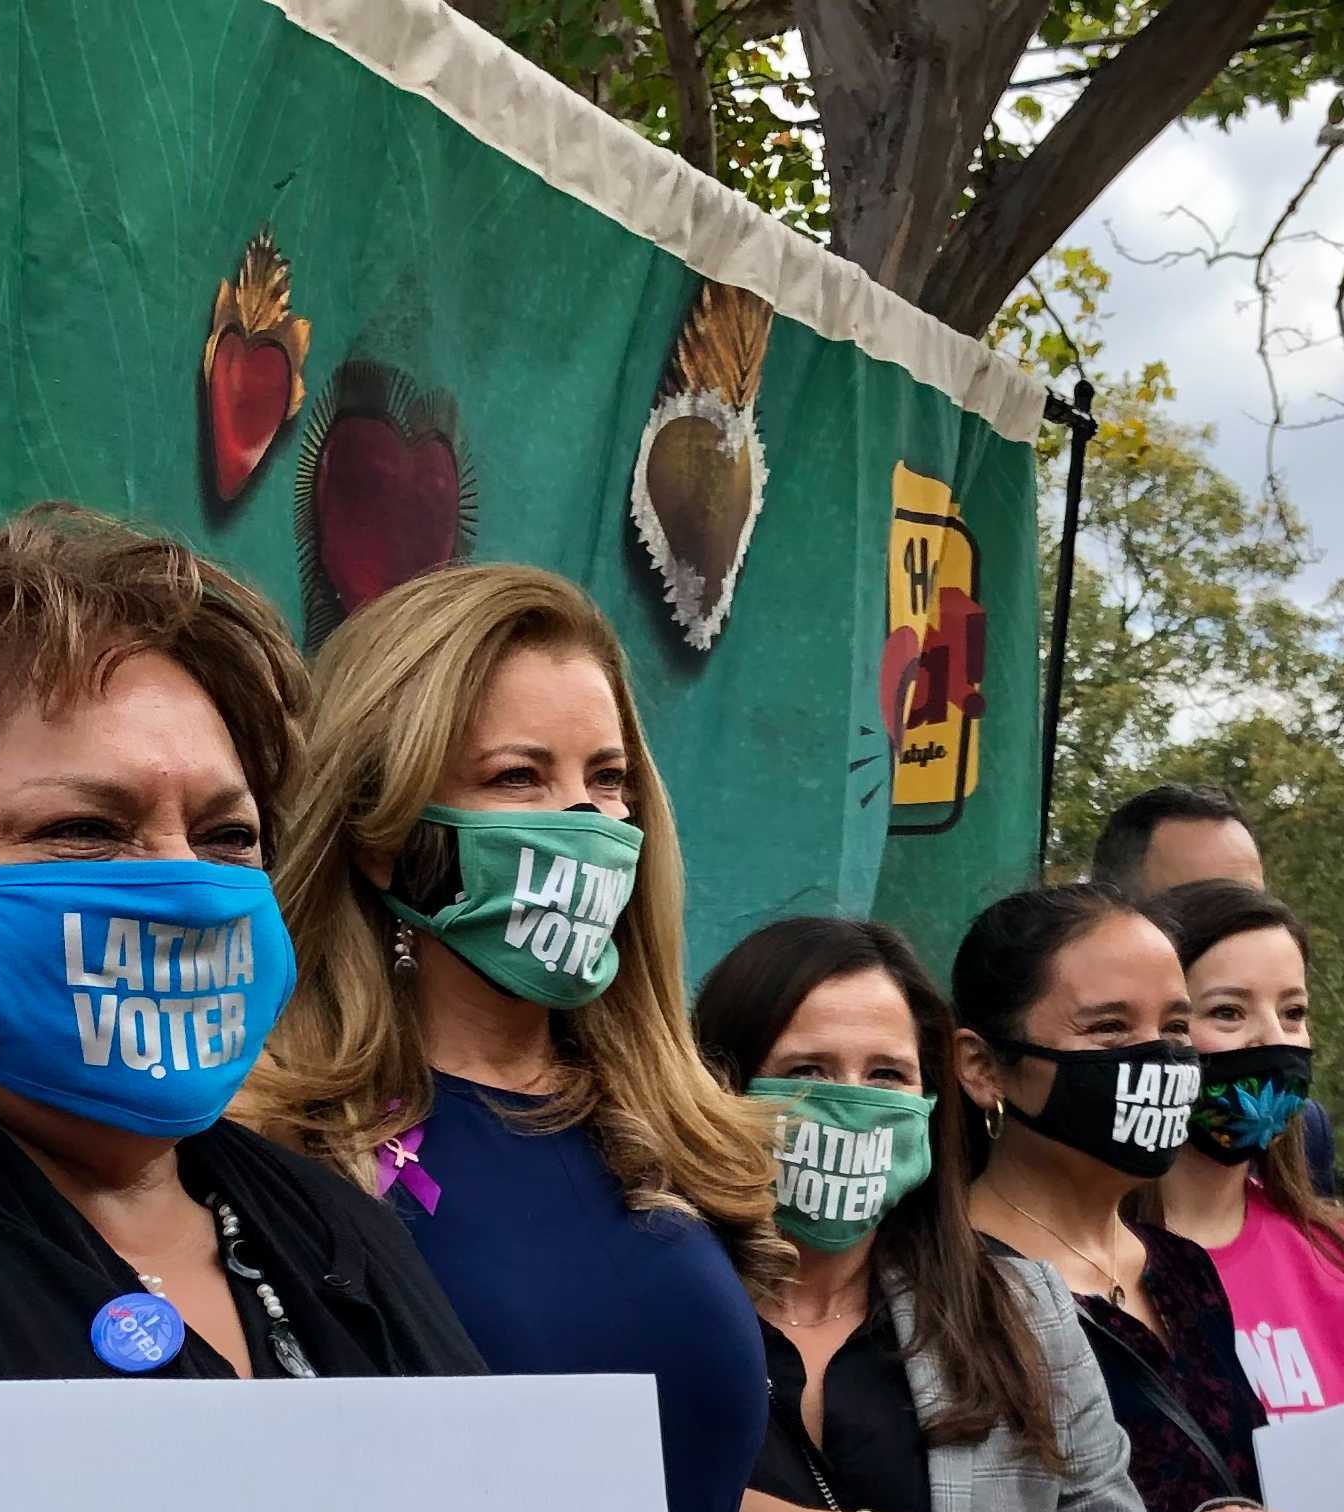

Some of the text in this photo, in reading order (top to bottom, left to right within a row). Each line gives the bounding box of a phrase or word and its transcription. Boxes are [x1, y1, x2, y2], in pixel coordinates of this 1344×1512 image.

[63, 912, 254, 992] LATINA
[73, 992, 246, 1078] VOTER
[772, 1115, 894, 1175] LATINA
[775, 1163, 887, 1221] VOTER
